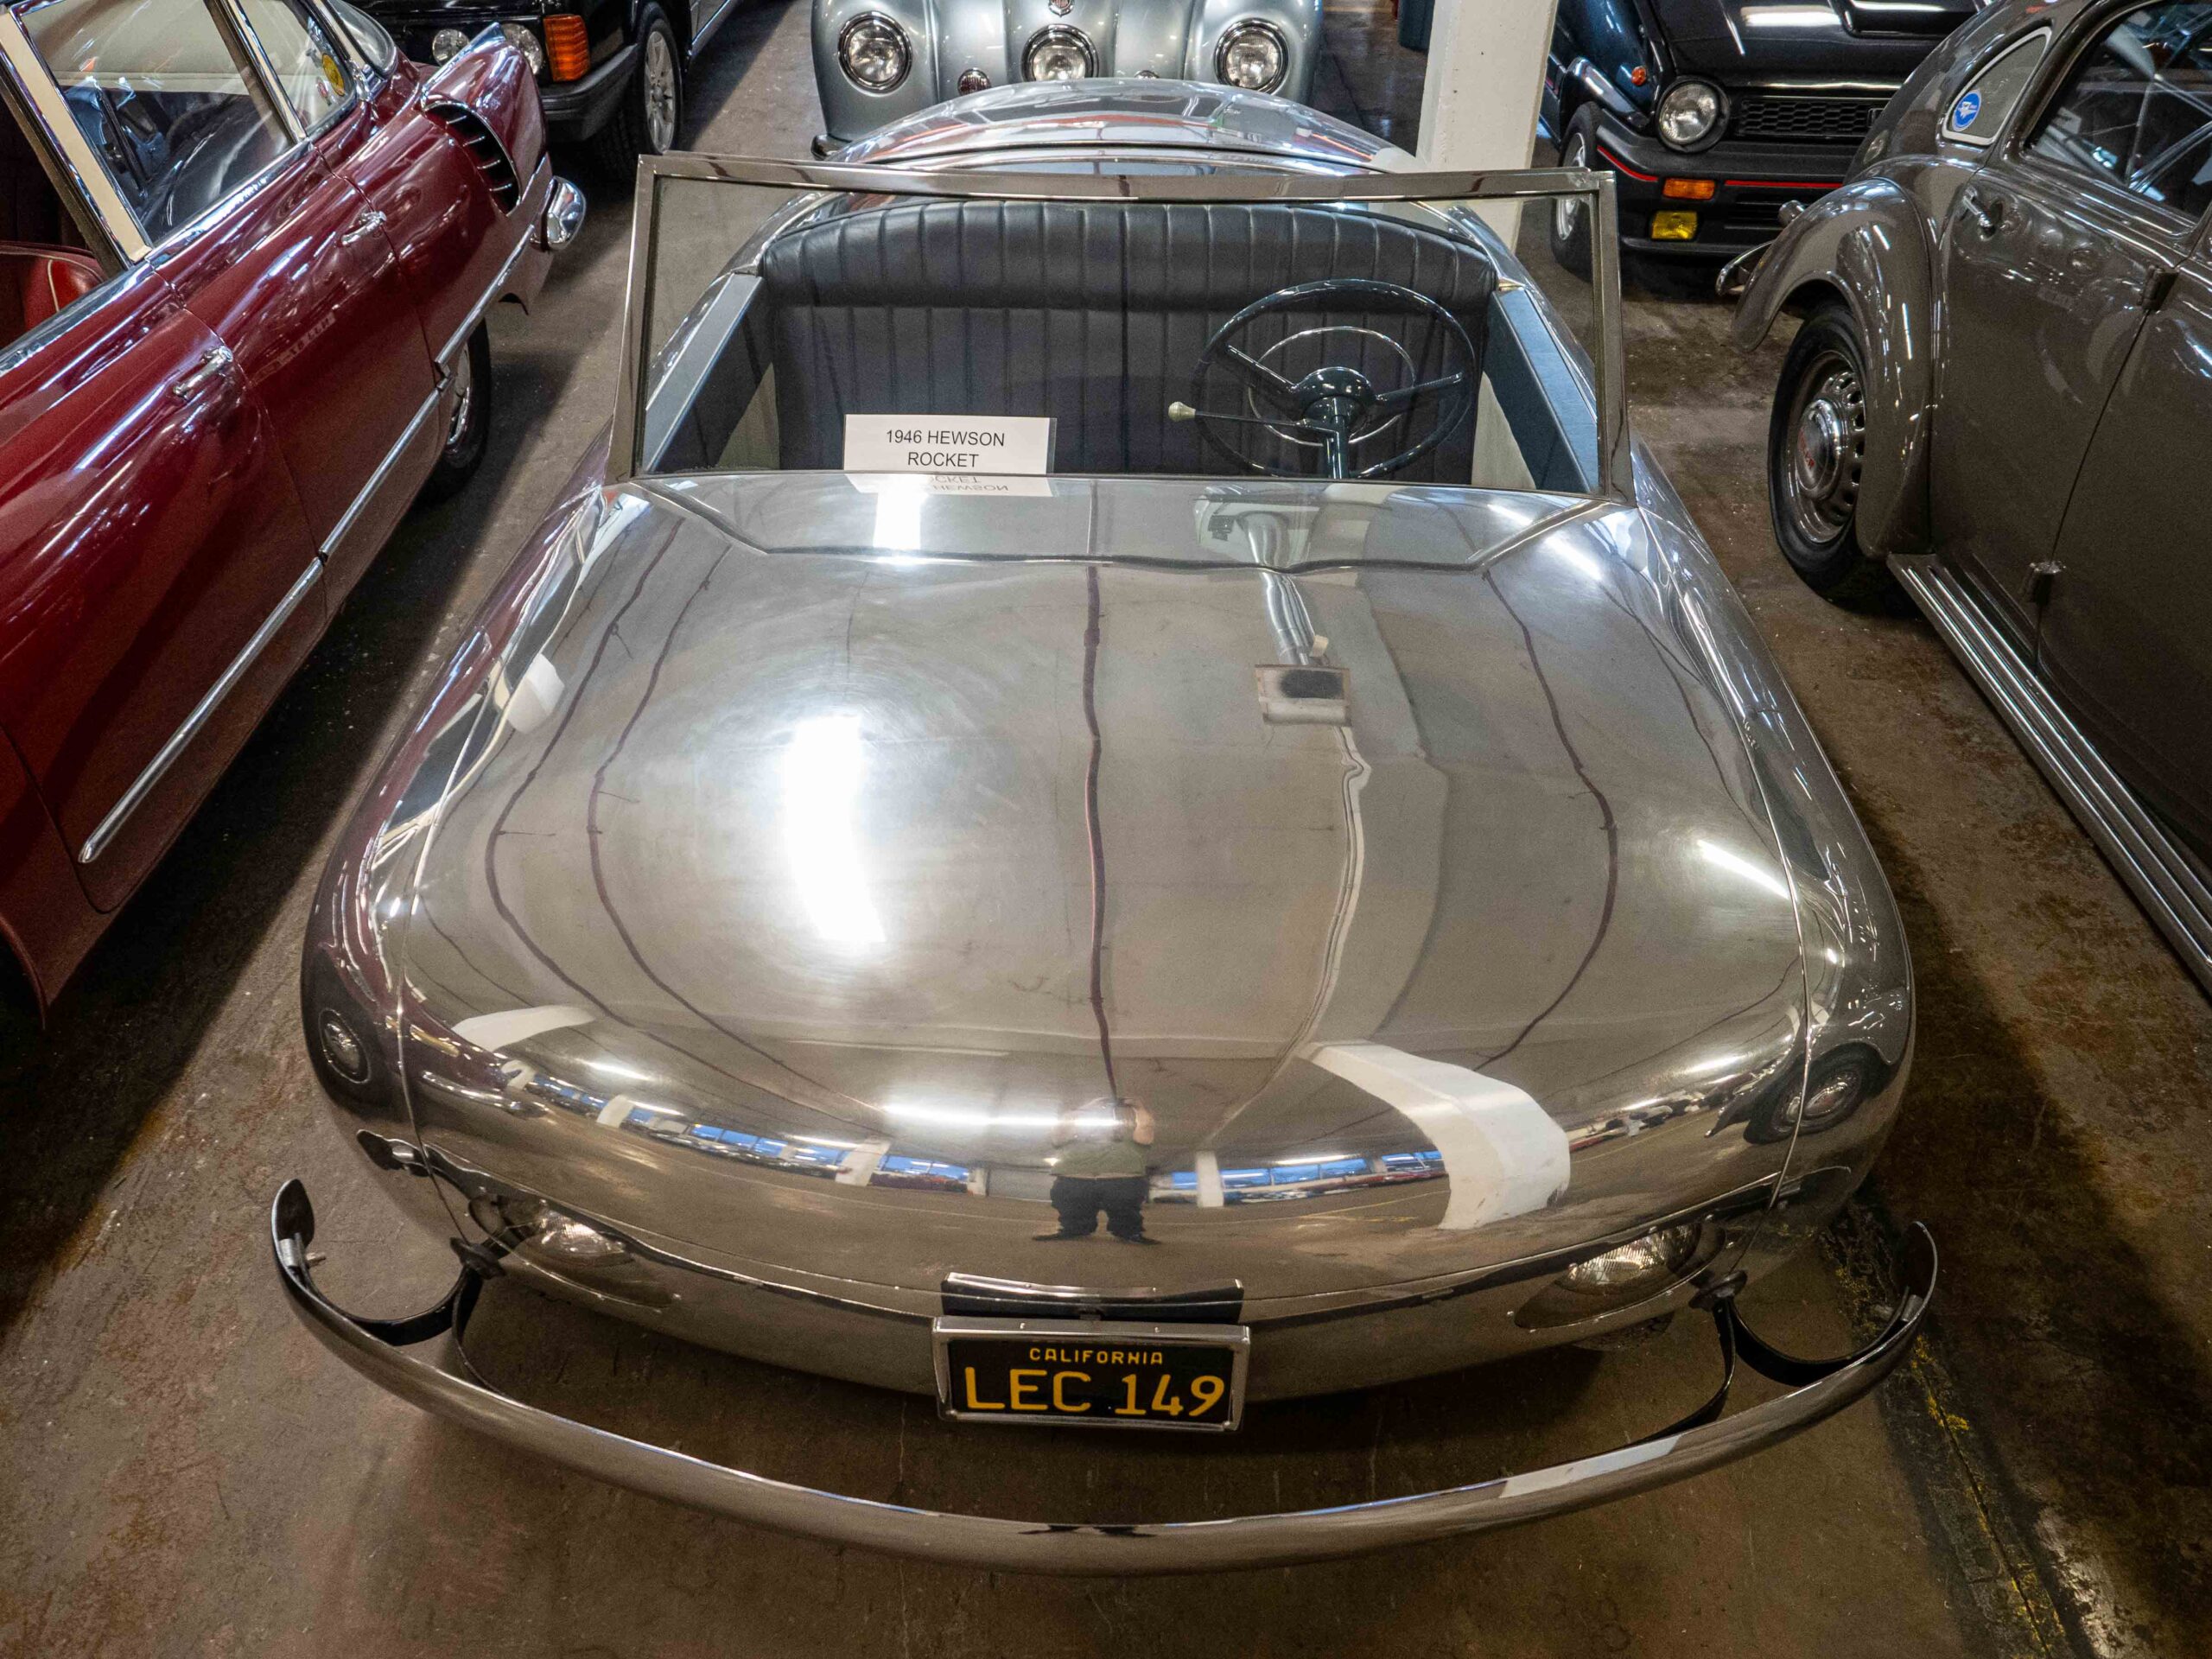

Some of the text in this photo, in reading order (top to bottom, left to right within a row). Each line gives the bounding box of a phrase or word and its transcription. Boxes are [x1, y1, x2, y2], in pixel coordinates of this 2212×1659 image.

[887, 429, 1005, 447] 1946 HEWSON
[907, 452, 979, 467] ROCKET
[1029, 1347, 1163, 1365] CALIFORNIA
[964, 1366, 1225, 1417] LEC 149
